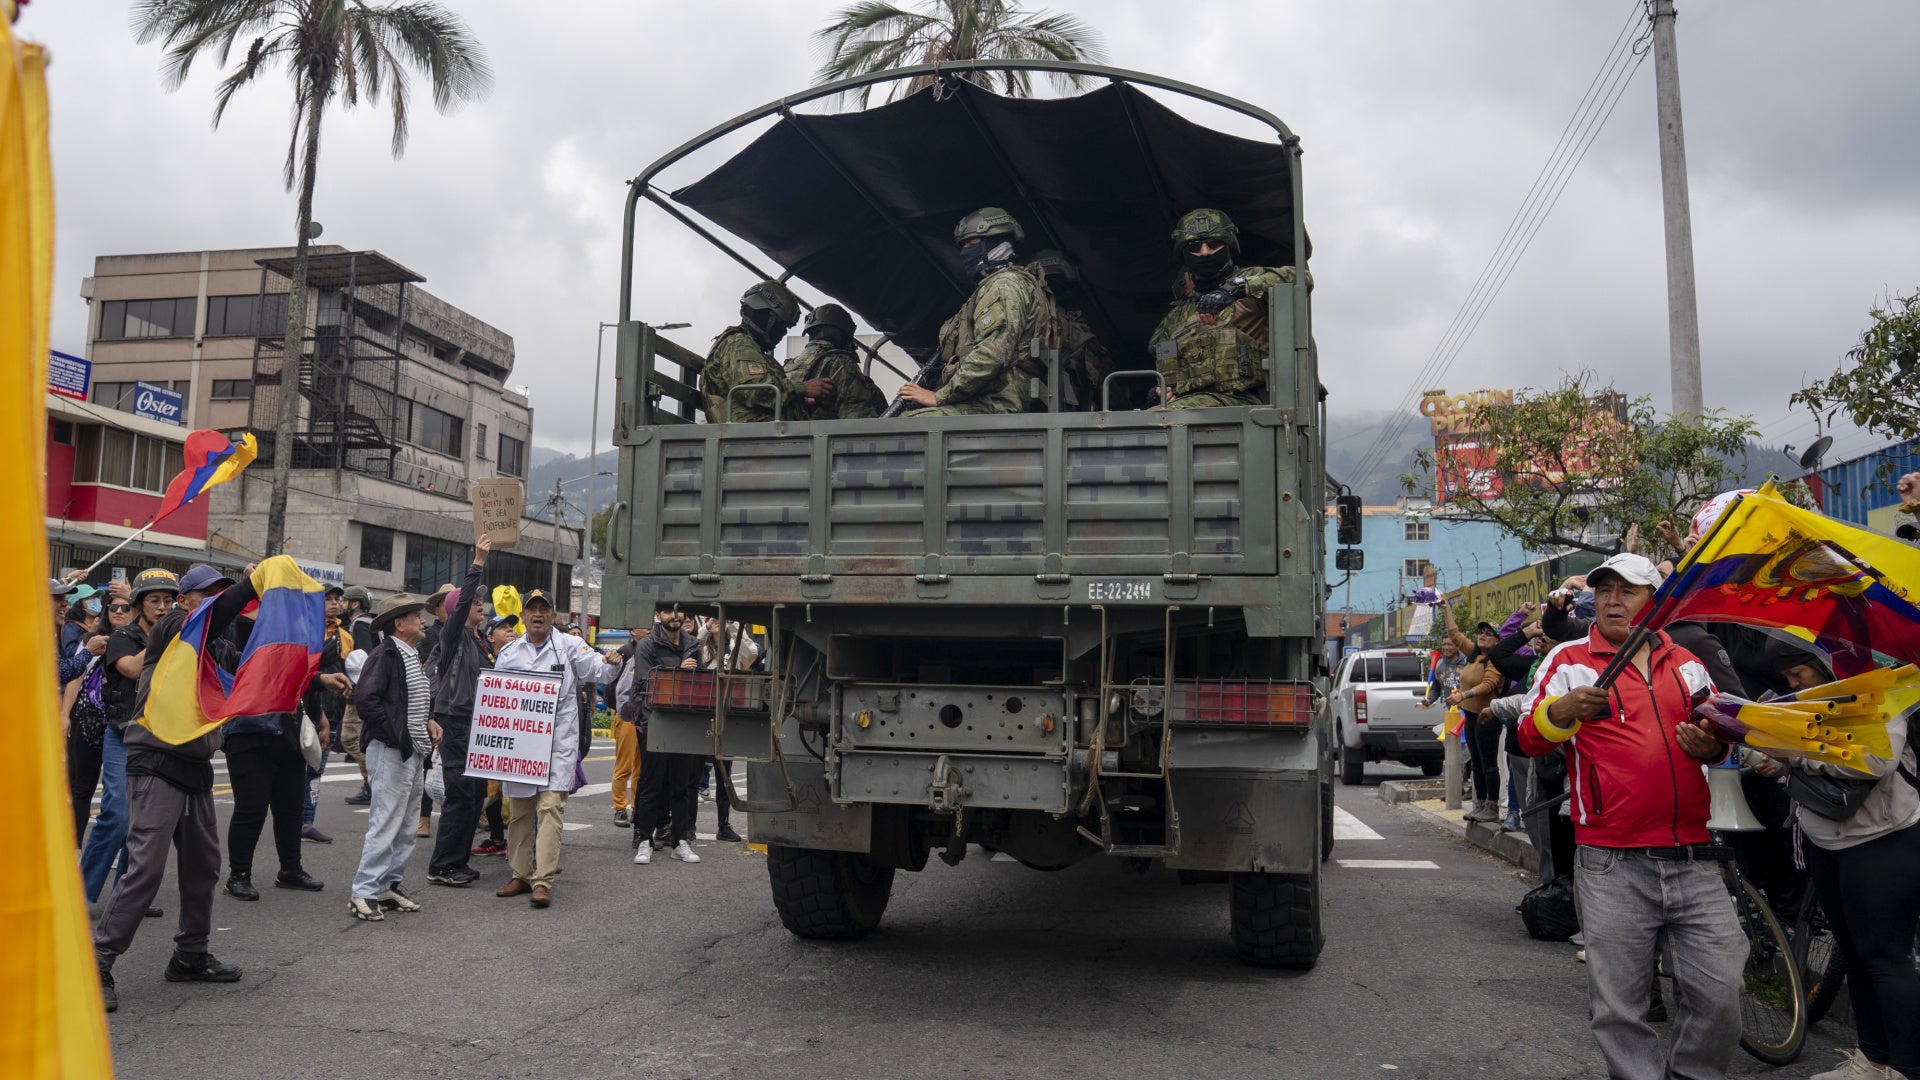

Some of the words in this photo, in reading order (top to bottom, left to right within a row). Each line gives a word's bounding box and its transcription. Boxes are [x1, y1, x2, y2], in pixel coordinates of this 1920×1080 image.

[137, 390, 179, 417] Oster
[1420, 389, 1513, 417] CROWN
[504, 496, 515, 506] NO
[483, 509, 491, 517] ME
[496, 508, 507, 517] SEA
[505, 679, 541, 693] SALUD
[543, 683, 557, 695] EL
[481, 694, 518, 710] PUEBLO
[520, 699, 554, 714] MUERE
[512, 718, 544, 734] HUELE
[545, 721, 552, 735] A
[475, 733, 515, 750] MUERTE
[468, 753, 494, 770] FUERA
[496, 756, 548, 778] MENTIROSO!!
